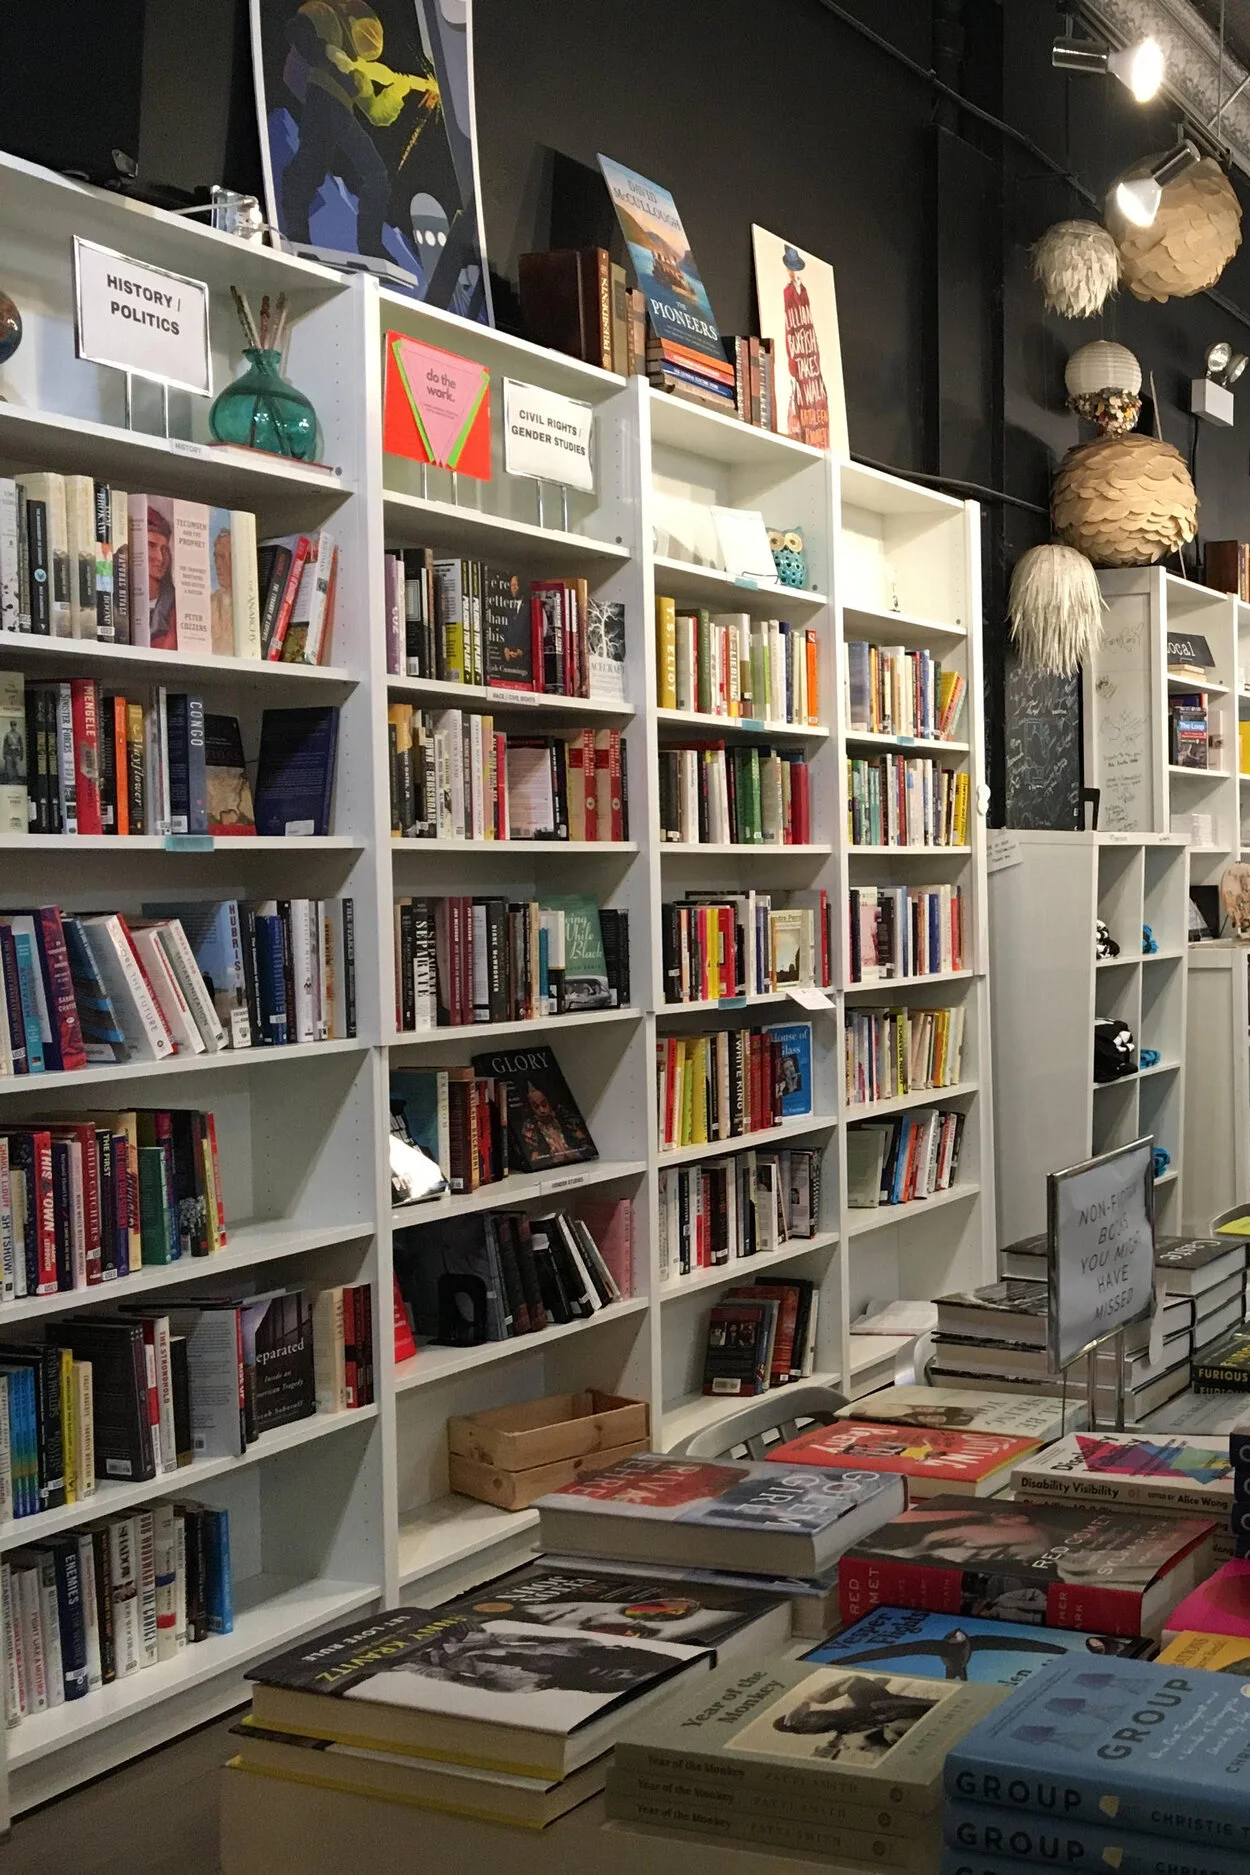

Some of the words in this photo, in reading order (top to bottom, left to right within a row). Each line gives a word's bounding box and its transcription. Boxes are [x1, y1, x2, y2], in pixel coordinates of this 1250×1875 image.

[628, 180, 657, 202] DAVID
[613, 188, 682, 231] McCULLOUGH
[107, 274, 173, 308] HISTORY
[111, 301, 180, 335] POLITICS
[650, 298, 718, 341] PIONEERS
[785, 306, 812, 328] LILLIAN
[426, 368, 439, 385] do
[441, 373, 456, 389] the
[795, 356, 818, 376] TAKES
[426, 384, 456, 402] work.
[519, 409, 544, 425] CIVIL
[547, 417, 577, 436] RIGHTS
[511, 425, 552, 444] GENDER
[554, 436, 586, 456] STUDIES
[667, 645, 675, 693] ELIOT
[84, 685, 96, 737] MENGELE
[189, 701, 204, 746] CONGO
[131, 728, 145, 806] Mayflower
[229, 904, 241, 971] HUBRIS
[570, 943, 603, 960] Black
[415, 920, 430, 998] SEPARATE
[491, 1051, 550, 1074] GLORY
[735, 1040, 744, 1077] WHITE
[41, 1148, 53, 1179] THIS
[87, 1139, 96, 1177] CHILD
[103, 1153, 111, 1177] FIRST
[43, 1190, 54, 1232] TOWN
[89, 1179, 98, 1242] CATCHERS
[1081, 1249, 1109, 1274] YOU
[1097, 1264, 1129, 1293] HAVE
[1092, 1287, 1134, 1322] MISSED
[160, 1330, 168, 1347] THE
[256, 1337, 305, 1365] eparated
[160, 1349, 170, 1404] STRONGHOLD
[1198, 1367, 1250, 1382] FURIOUS
[1021, 1477, 1070, 1494] Disability
[1072, 1482, 1120, 1498] Visibility
[1177, 1494, 1199, 1506] Alice
[1202, 1497, 1229, 1511] Wong
[118, 1525, 131, 1578] SHADOW
[1032, 1546, 1070, 1570] RED
[65, 1554, 79, 1605] ENEMIES
[849, 1577, 860, 1616] RED
[344, 1625, 382, 1647] LOVE
[385, 1614, 411, 1632] LET
[828, 1612, 894, 1650] Vesper
[301, 1641, 340, 1663] RULE
[314, 1638, 407, 1683] KRAVITZ
[682, 1698, 726, 1728] Year
[740, 1669, 768, 1688] the
[718, 1678, 787, 1725] Monkey
[1097, 1678, 1197, 1761] GROUP
[648, 1755, 671, 1768] Year
[684, 1762, 702, 1772] the
[704, 1763, 746, 1779] Monkey
[637, 1780, 662, 1794] Year
[675, 1786, 692, 1798] the
[694, 1787, 736, 1804] Monkey
[956, 1771, 1083, 1812] GROUP
[1151, 1810, 1233, 1836] CHRISTIE
[956, 1822, 1085, 1864] GROUP
